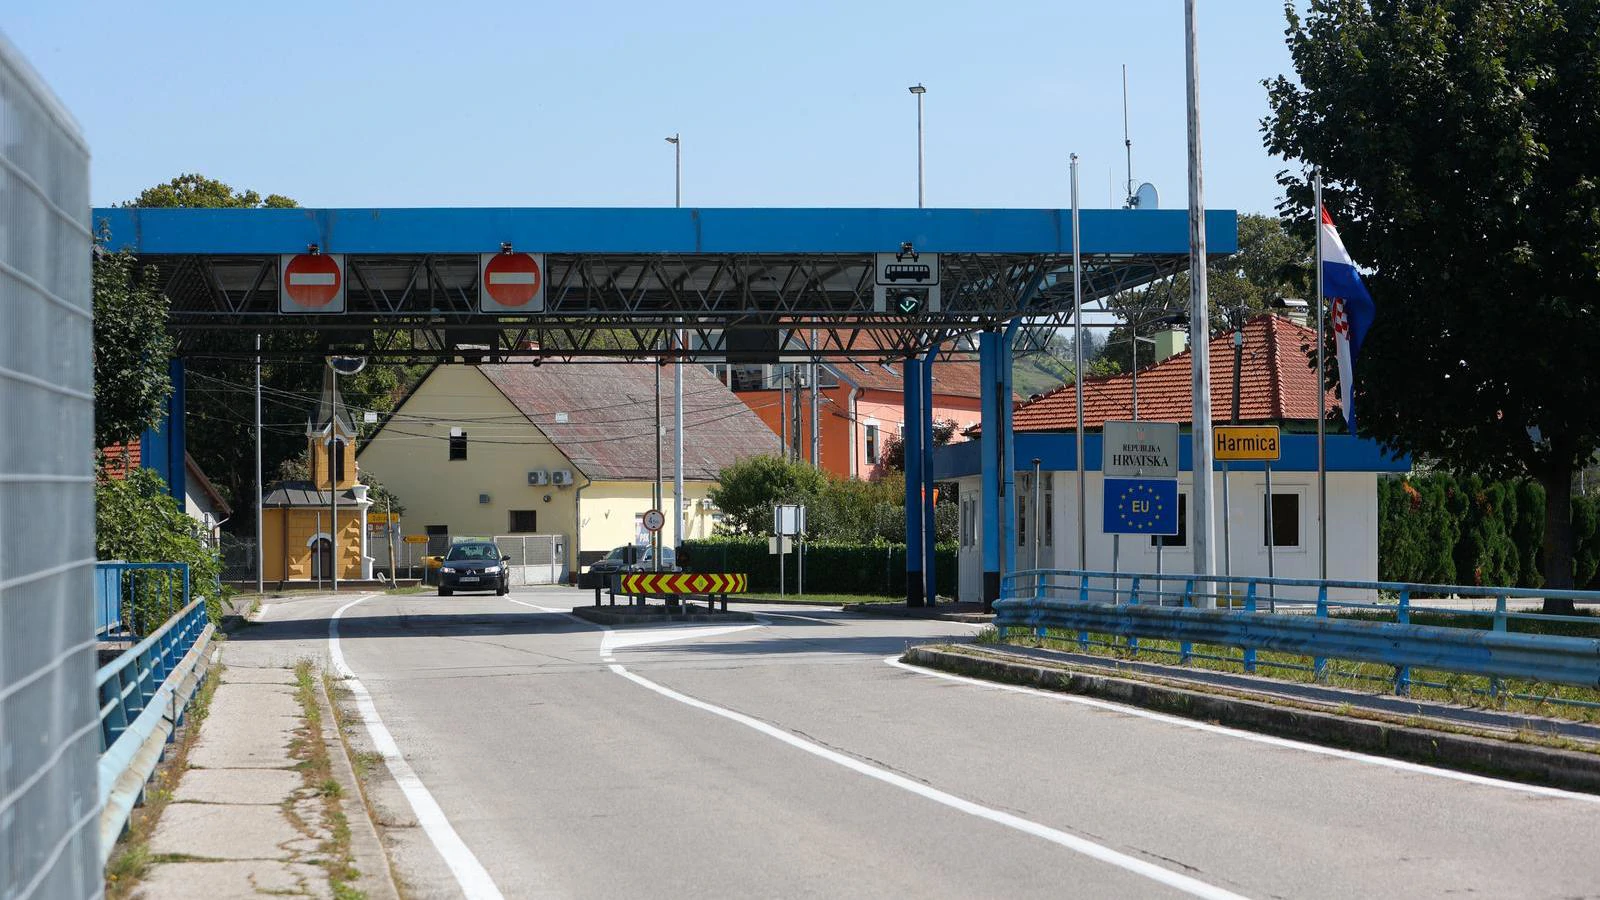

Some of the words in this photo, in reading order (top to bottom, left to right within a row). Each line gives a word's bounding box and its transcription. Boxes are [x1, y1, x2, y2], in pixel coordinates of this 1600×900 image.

[1123, 444, 1161, 452] REPUBLIKA
[1217, 433, 1276, 451] Harmica
[1113, 454, 1169, 467] HRVATSKA
[1132, 500, 1150, 512] EU
